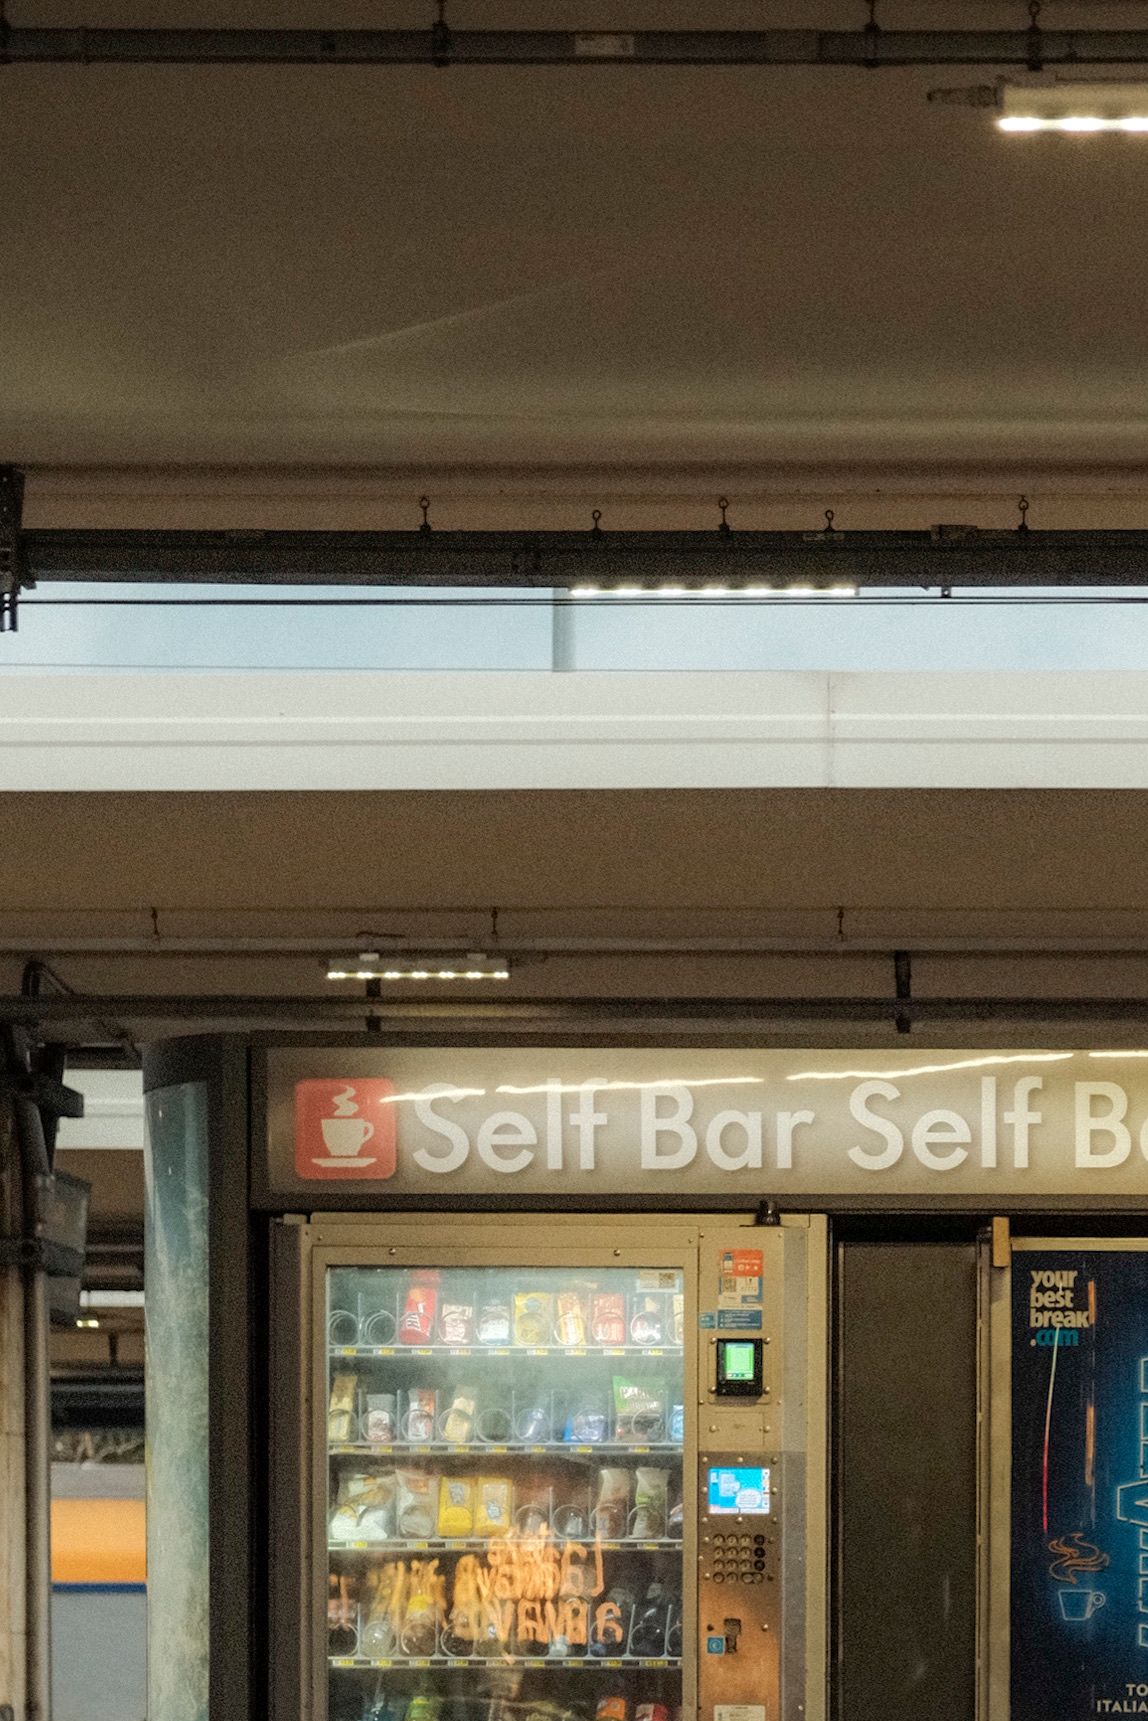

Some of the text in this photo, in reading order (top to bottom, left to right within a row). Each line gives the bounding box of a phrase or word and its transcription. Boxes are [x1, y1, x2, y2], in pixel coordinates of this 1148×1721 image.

[412, 1076, 607, 1173] Self
[640, 1085, 813, 1173] Bar
[848, 1075, 1043, 1173] Self
[1030, 1270, 1078, 1289] your
[1030, 1286, 1074, 1308] best
[1030, 1308, 1089, 1328] break
